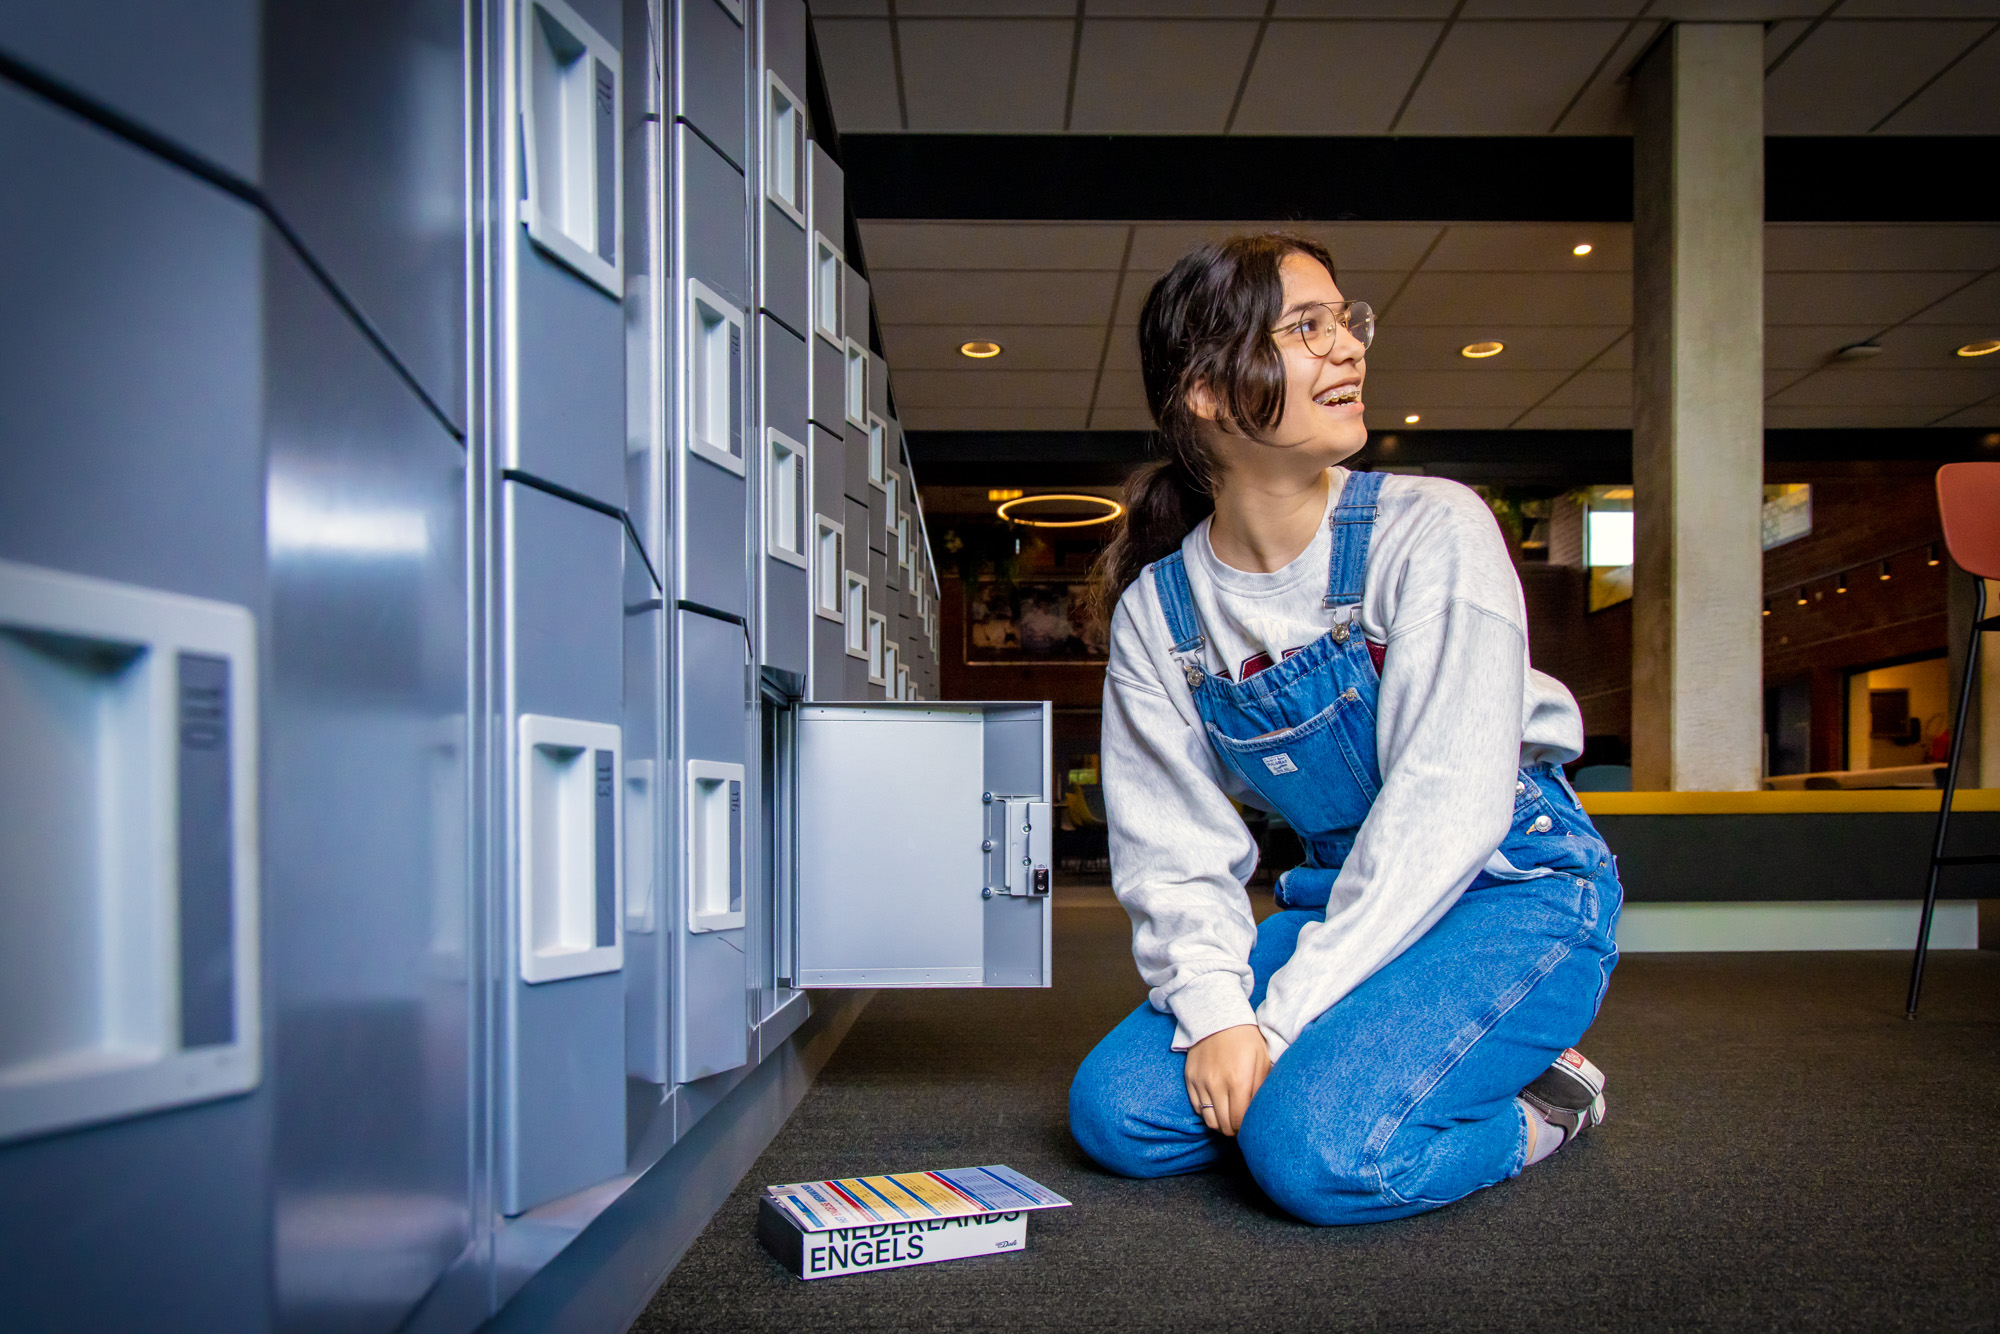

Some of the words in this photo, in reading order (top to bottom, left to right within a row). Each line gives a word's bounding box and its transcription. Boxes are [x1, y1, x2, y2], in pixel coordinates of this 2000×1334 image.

[597, 766, 611, 797] 113
[731, 791, 739, 812] 116
[810, 1235, 924, 1273] ENGELS
